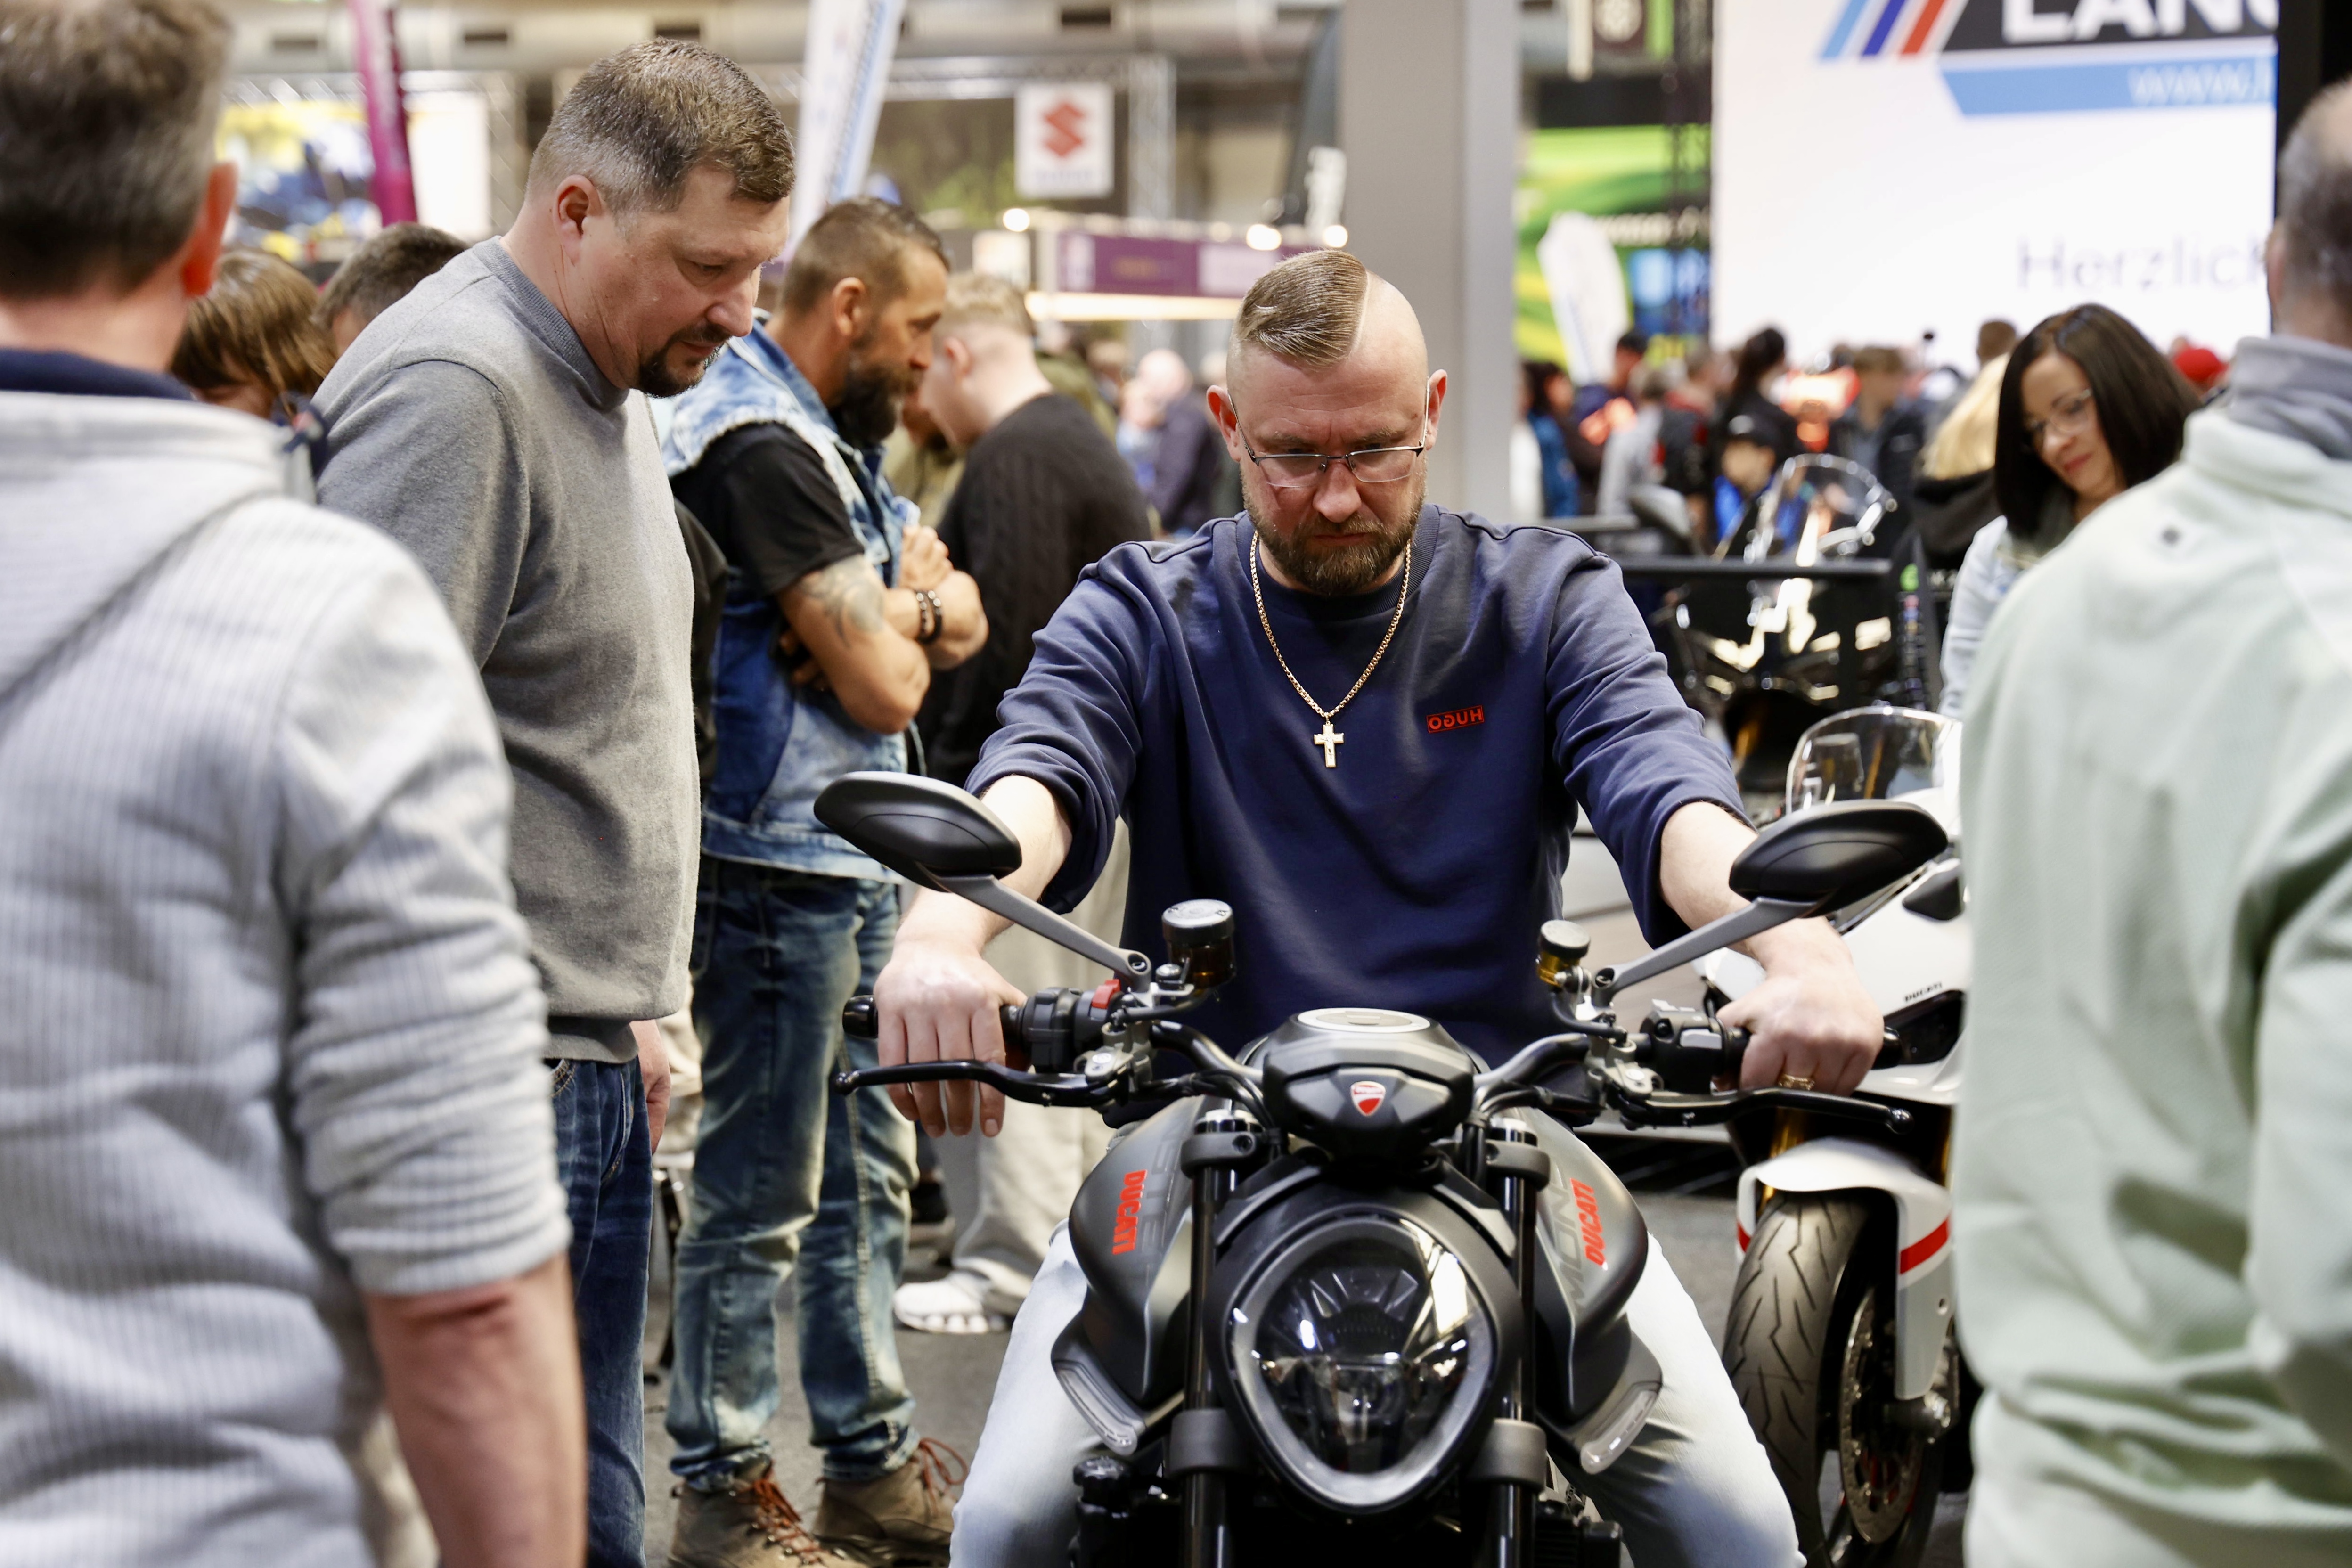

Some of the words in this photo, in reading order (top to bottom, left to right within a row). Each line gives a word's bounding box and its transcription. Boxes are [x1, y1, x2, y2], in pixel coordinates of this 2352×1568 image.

[2002, 0, 2278, 44] LAN
[1111, 1169, 1148, 1255] DUCATI
[1569, 1177, 1608, 1270] DUCATI
